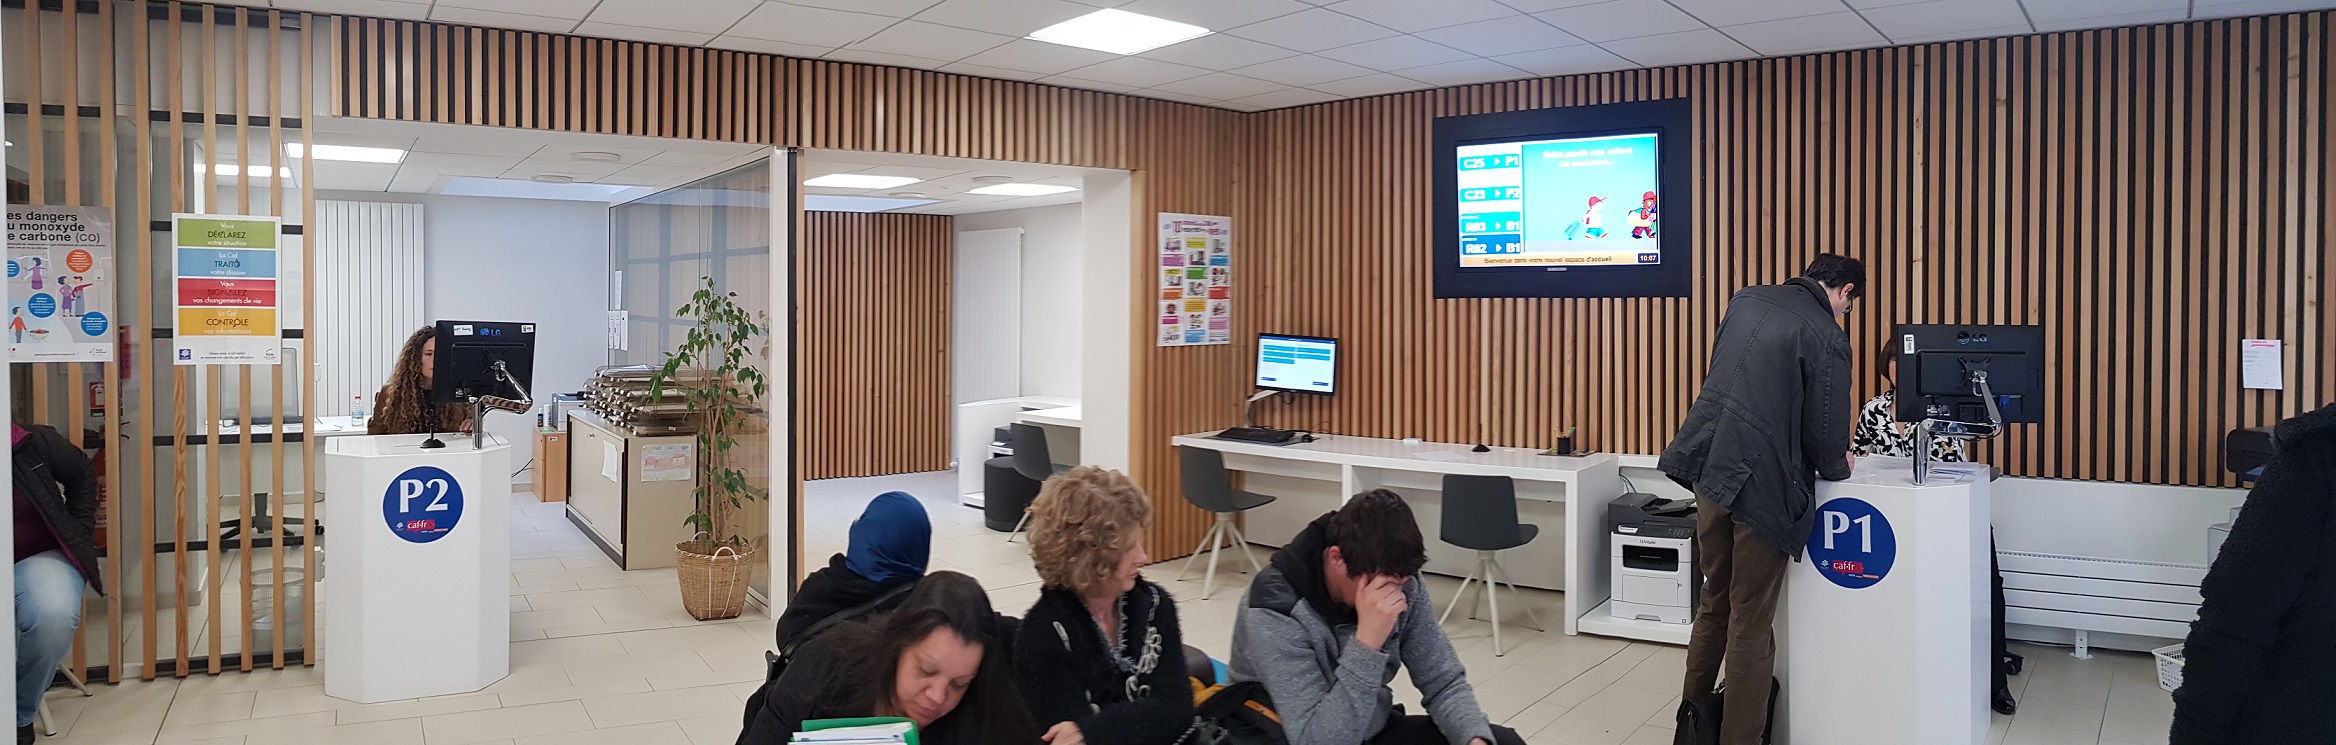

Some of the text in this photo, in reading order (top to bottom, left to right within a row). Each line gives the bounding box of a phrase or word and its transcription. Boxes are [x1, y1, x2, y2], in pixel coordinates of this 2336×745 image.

[1463, 155, 1519, 169] C25 P1
[1505, 187, 1520, 198] P2
[7, 211, 78, 223] es dangers
[7, 222, 86, 233] u monoxyde
[1505, 220, 1520, 231] B1
[7, 232, 100, 244] e carbone (CO)
[207, 230, 246, 239] DÉCLAREZ
[1505, 242, 1521, 253] B1
[207, 288, 248, 296] SIGNALEZ
[204, 297, 243, 305] changements
[226, 309, 237, 317] Caf
[206, 317, 249, 328] CONTRÔLE
[491, 329, 501, 337] LG
[1972, 333, 1988, 342] LG
[399, 478, 449, 514] P2
[1823, 510, 1872, 554] P1
